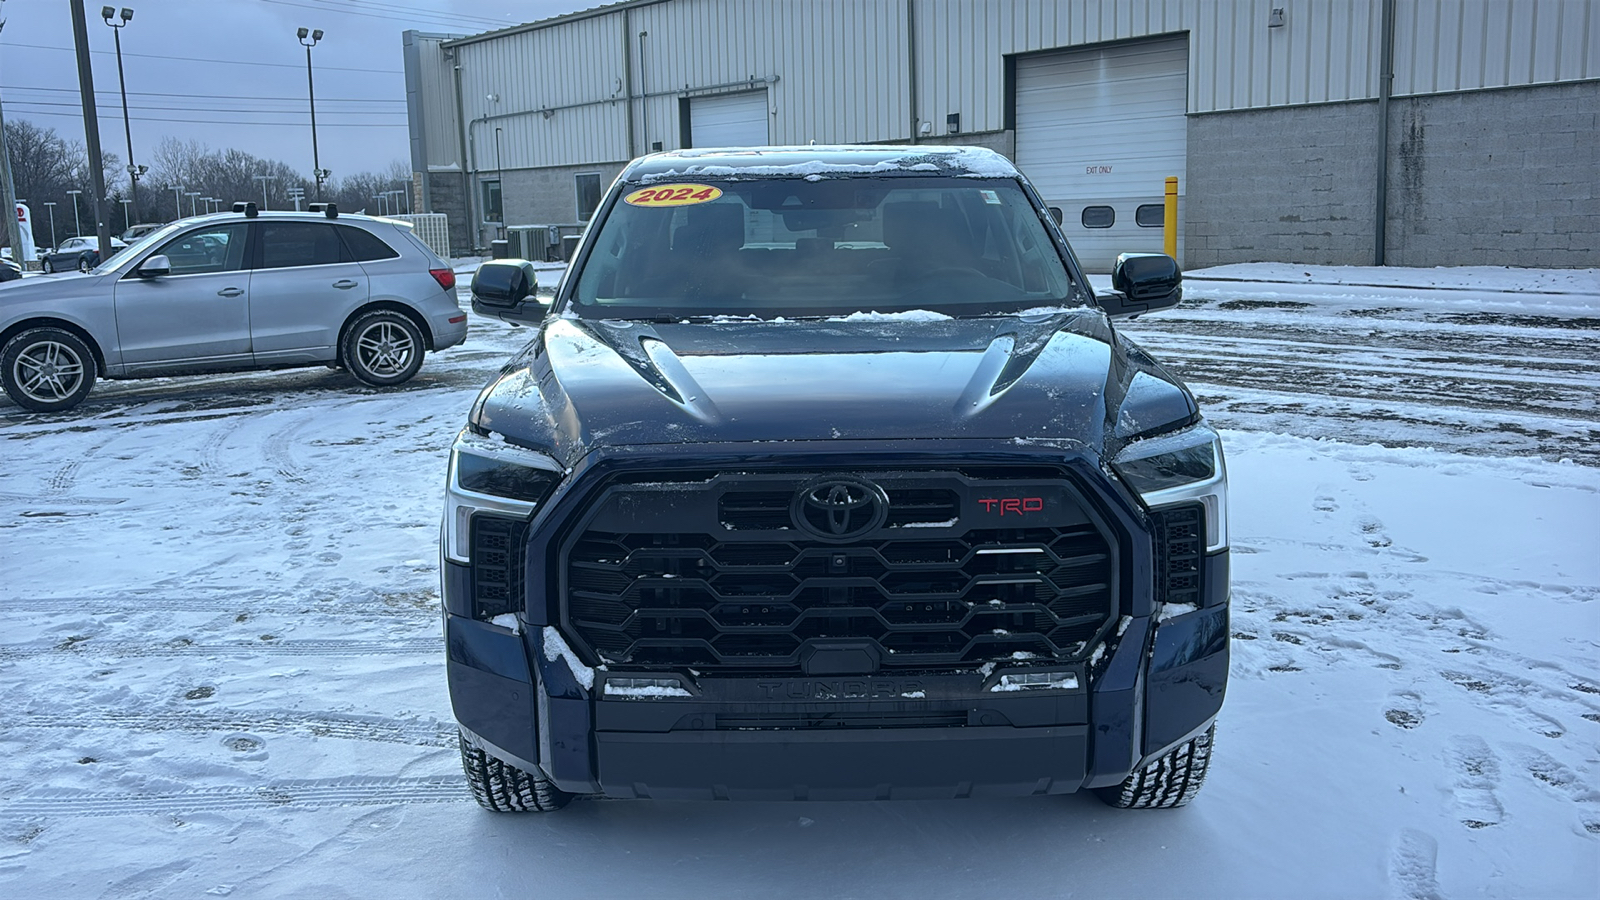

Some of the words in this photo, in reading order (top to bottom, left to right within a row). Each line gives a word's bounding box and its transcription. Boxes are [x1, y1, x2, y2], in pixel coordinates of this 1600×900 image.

[1086, 166, 1098, 174] EXIT
[1099, 165, 1113, 174] ONLY
[632, 188, 715, 203] 2024
[978, 497, 1043, 516] TRD
[757, 681, 926, 699] TUNDRA
